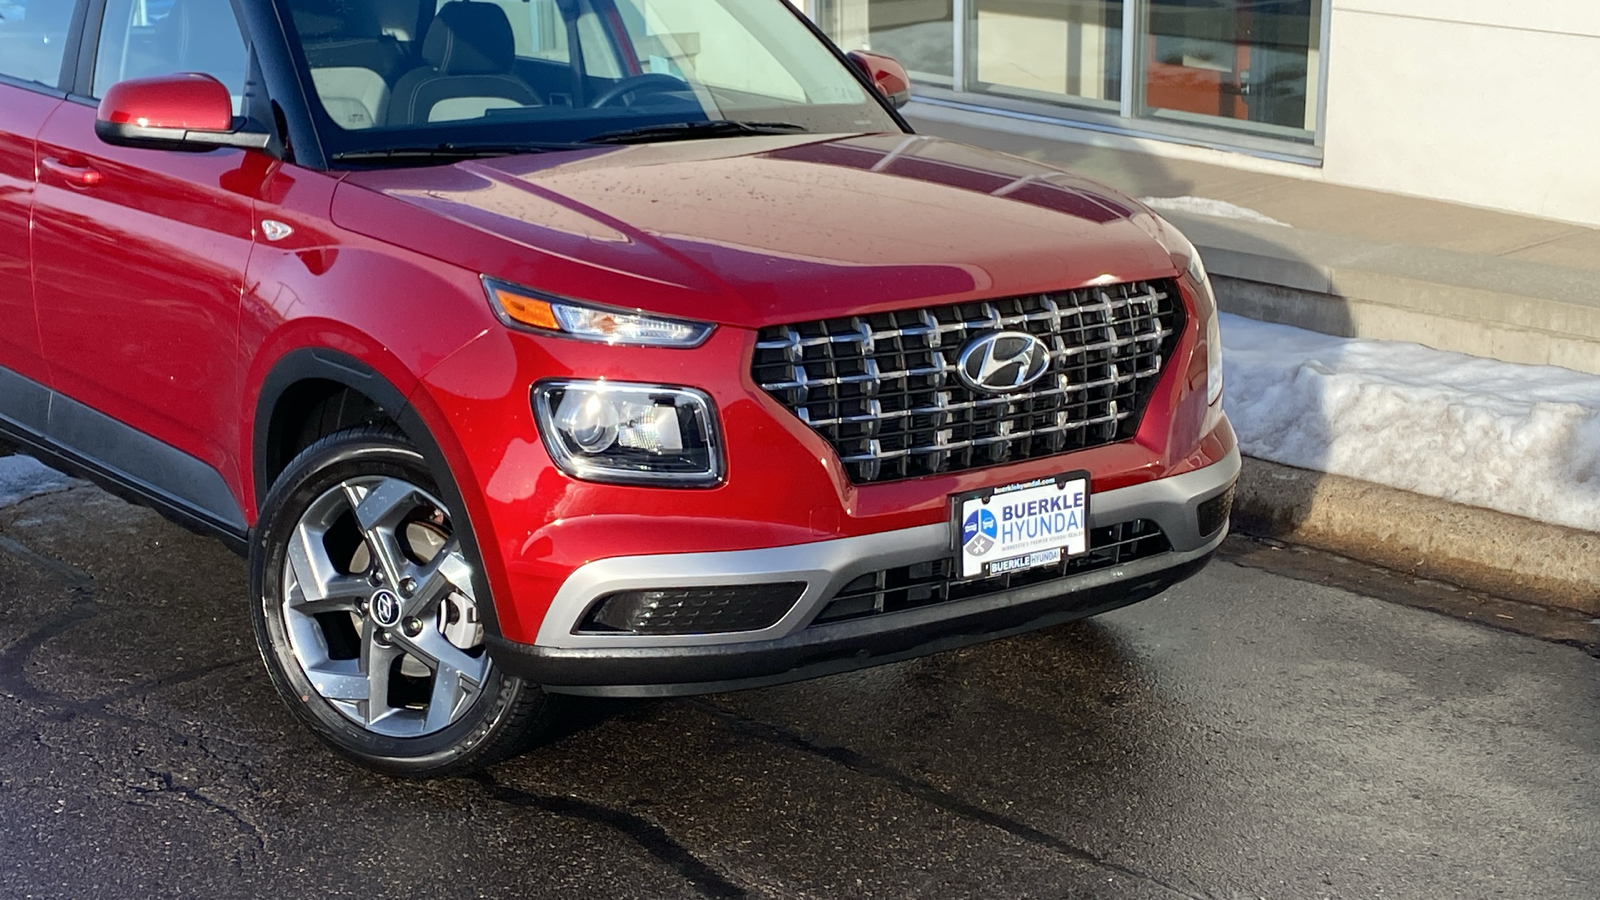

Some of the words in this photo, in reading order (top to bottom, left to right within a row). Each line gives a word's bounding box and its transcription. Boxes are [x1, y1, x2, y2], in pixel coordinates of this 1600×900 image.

[1002, 492, 1083, 521] BUERKLE
[1002, 508, 1084, 544] HYUNDAI
[991, 556, 1030, 573] BUERKLE
[1031, 549, 1060, 565] HYUNDAI
